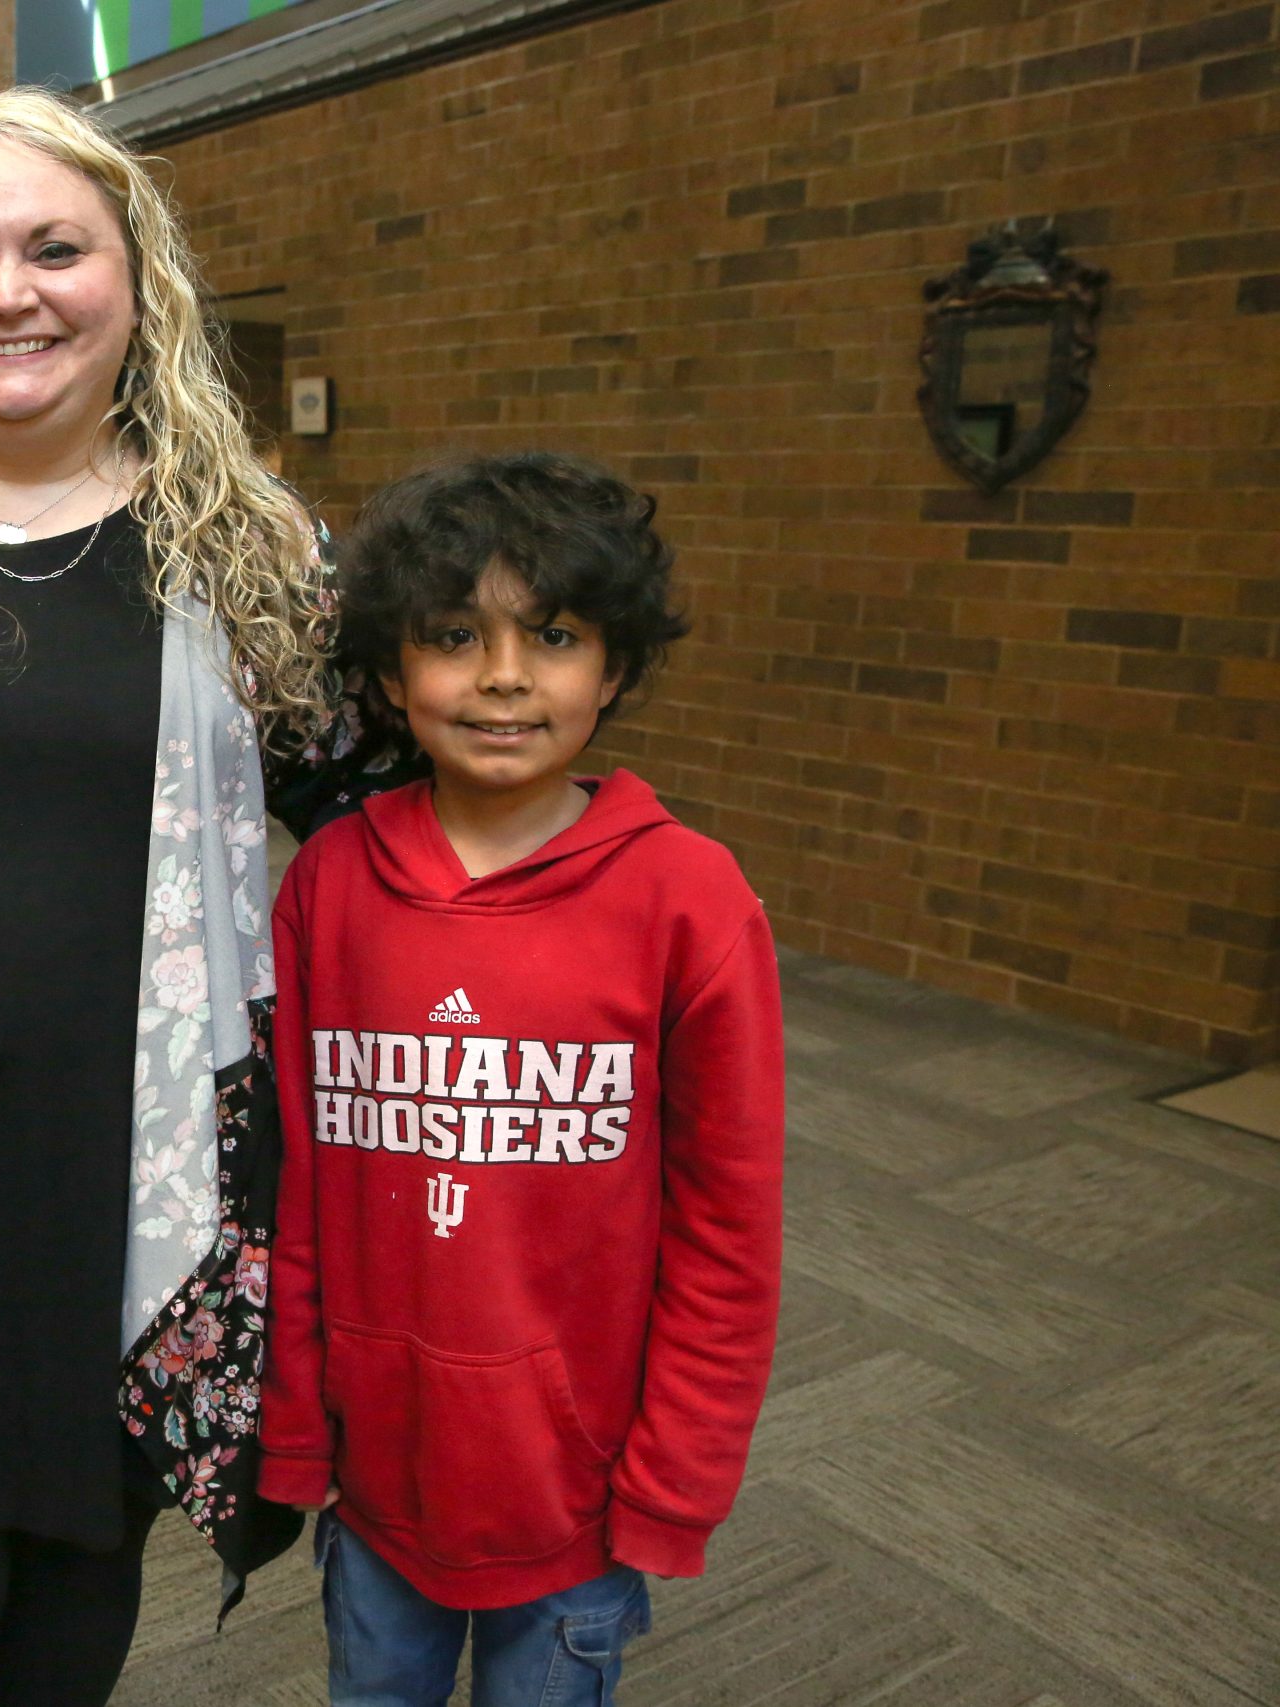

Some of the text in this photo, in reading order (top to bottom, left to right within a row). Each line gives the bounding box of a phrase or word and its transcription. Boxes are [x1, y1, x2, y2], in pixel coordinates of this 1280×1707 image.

[428, 1009, 481, 1024] adidas
[312, 1029, 636, 1103] INDIANA
[313, 1090, 632, 1164] HOOSIERS
